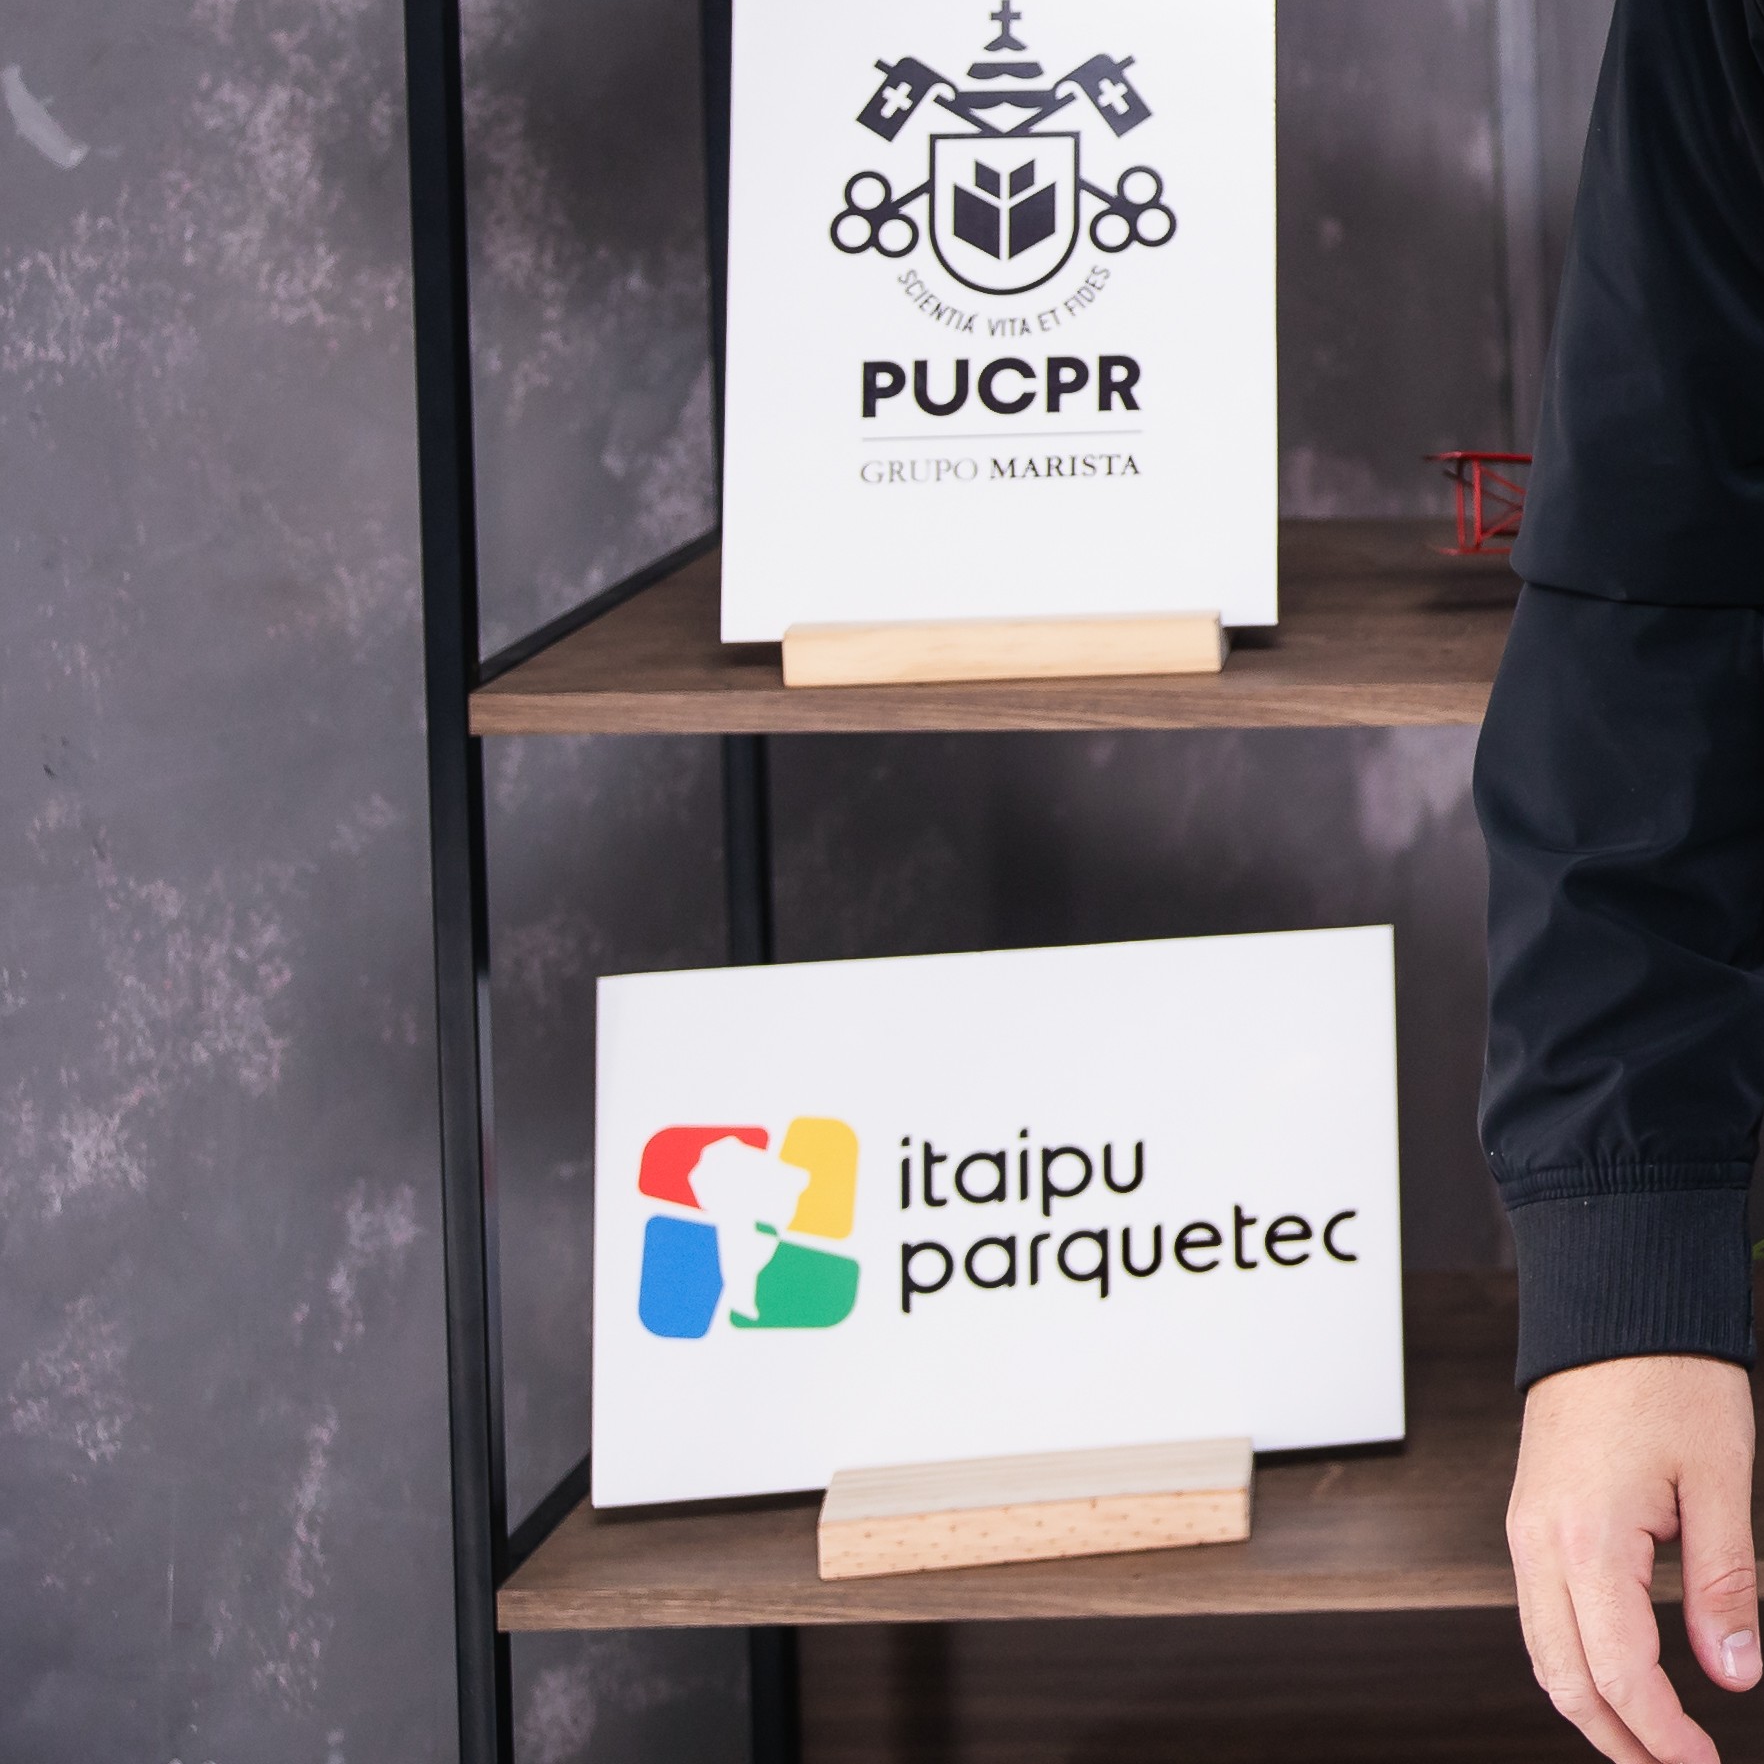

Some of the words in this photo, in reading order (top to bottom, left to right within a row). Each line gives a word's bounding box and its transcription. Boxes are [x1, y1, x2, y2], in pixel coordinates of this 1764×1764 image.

[987, 316, 1032, 337] VITA
[1037, 306, 1062, 333] ET
[1063, 263, 1111, 317] FIDES
[862, 354, 1142, 419] PUCPR
[859, 457, 979, 484] GRUPO
[989, 452, 1142, 481] MARISTA
[899, 1126, 1146, 1217] itaipu
[899, 1203, 1359, 1314] parquetec
